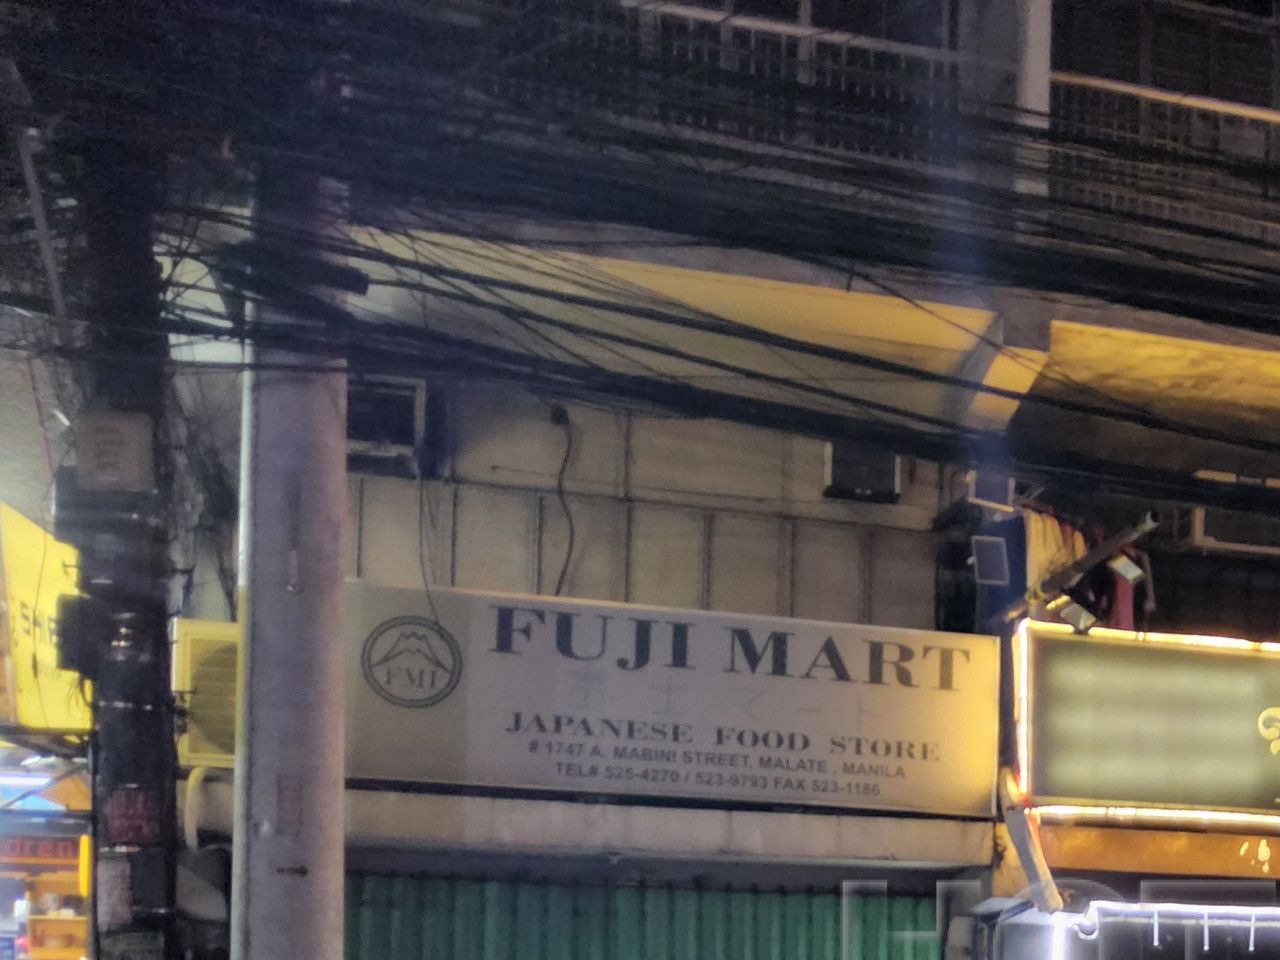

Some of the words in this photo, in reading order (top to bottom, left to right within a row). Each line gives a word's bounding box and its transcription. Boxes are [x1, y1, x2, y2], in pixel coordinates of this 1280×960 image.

[488, 604, 697, 672] FUJI
[722, 626, 971, 690] MART
[384, 665, 438, 690] FMI
[506, 712, 693, 743] JAPANESE
[715, 727, 810, 751] FOOD
[830, 735, 940, 761] STORE
[546, 741, 585, 757] 1747
[614, 746, 676, 763] MABINI
[759, 756, 828, 773] MALATE
[843, 762, 906, 778] MANILA
[555, 762, 599, 777] TEL#
[774, 776, 806, 791] FAX
